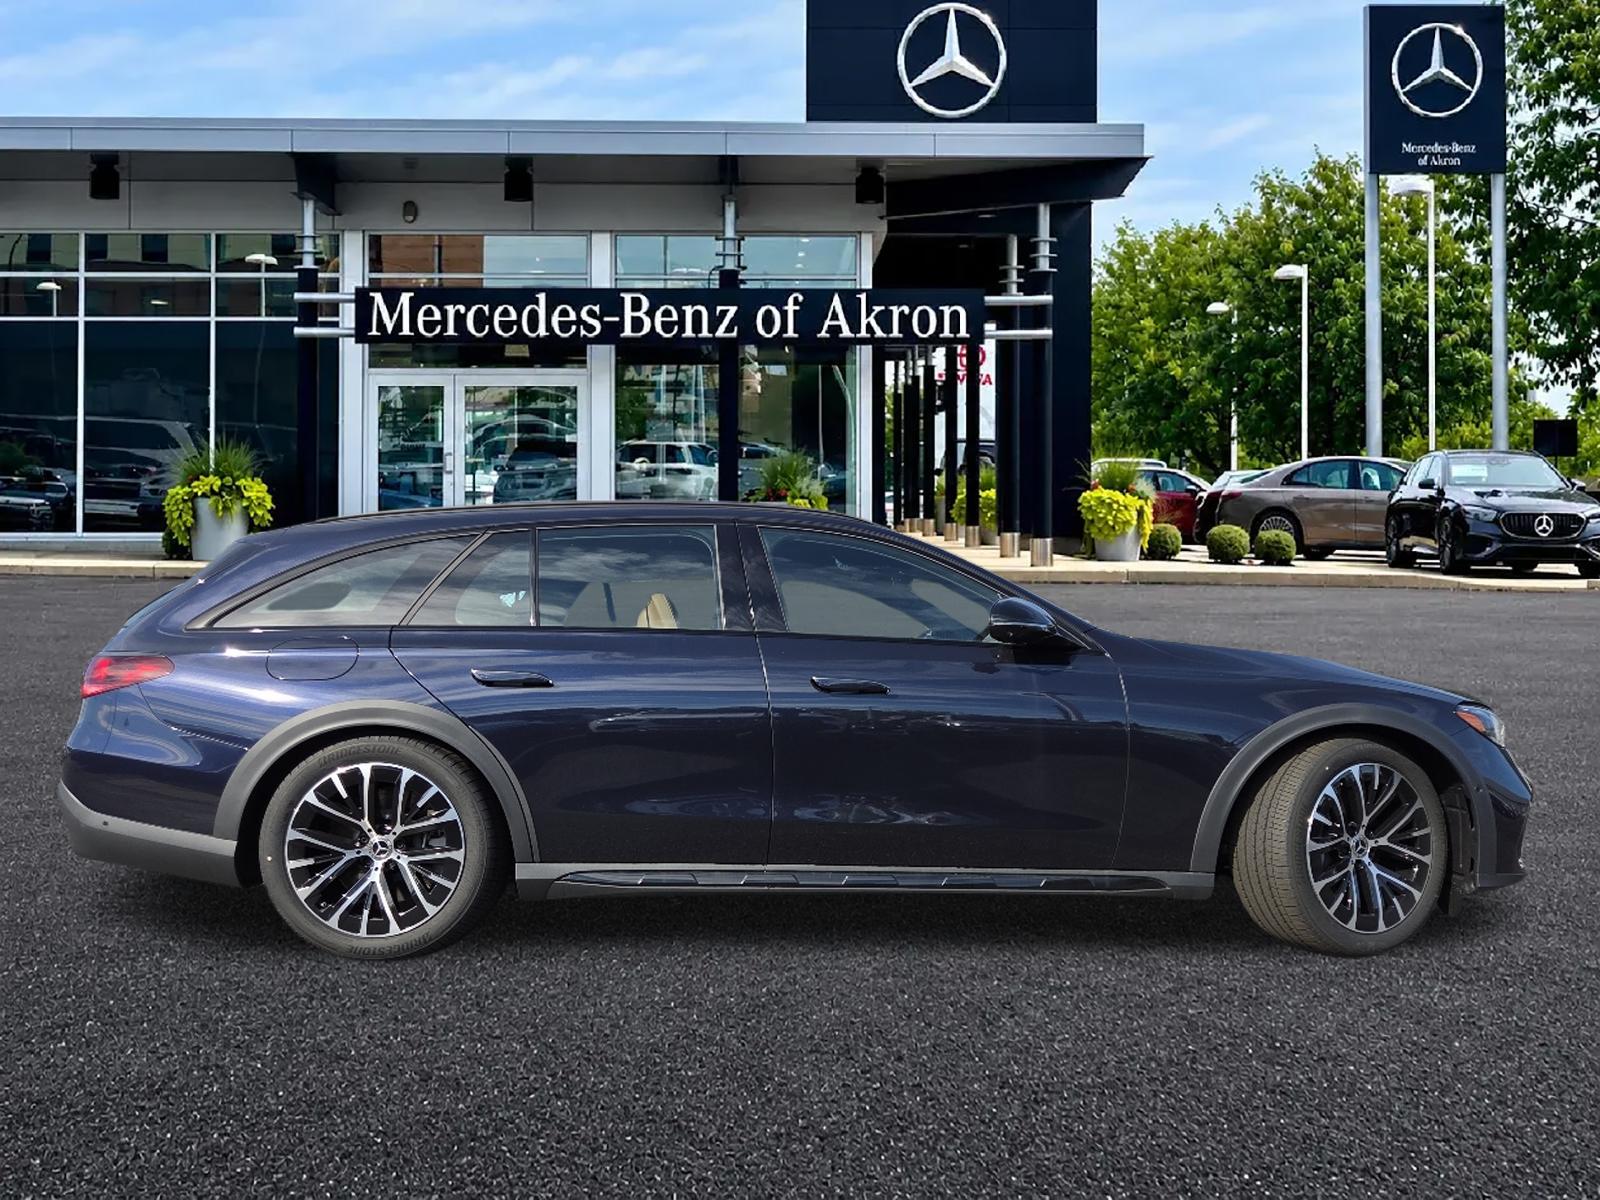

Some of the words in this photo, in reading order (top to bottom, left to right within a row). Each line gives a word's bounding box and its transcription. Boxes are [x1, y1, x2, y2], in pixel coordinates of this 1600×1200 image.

[1402, 142, 1476, 153] Mercedes-Benz
[1418, 154, 1428, 165] of
[1430, 154, 1461, 165] Akron
[368, 291, 739, 339] Mercedes-Benz
[755, 291, 804, 338] of
[819, 293, 970, 339] Akron
[319, 744, 403, 768] BRIDGESTONE
